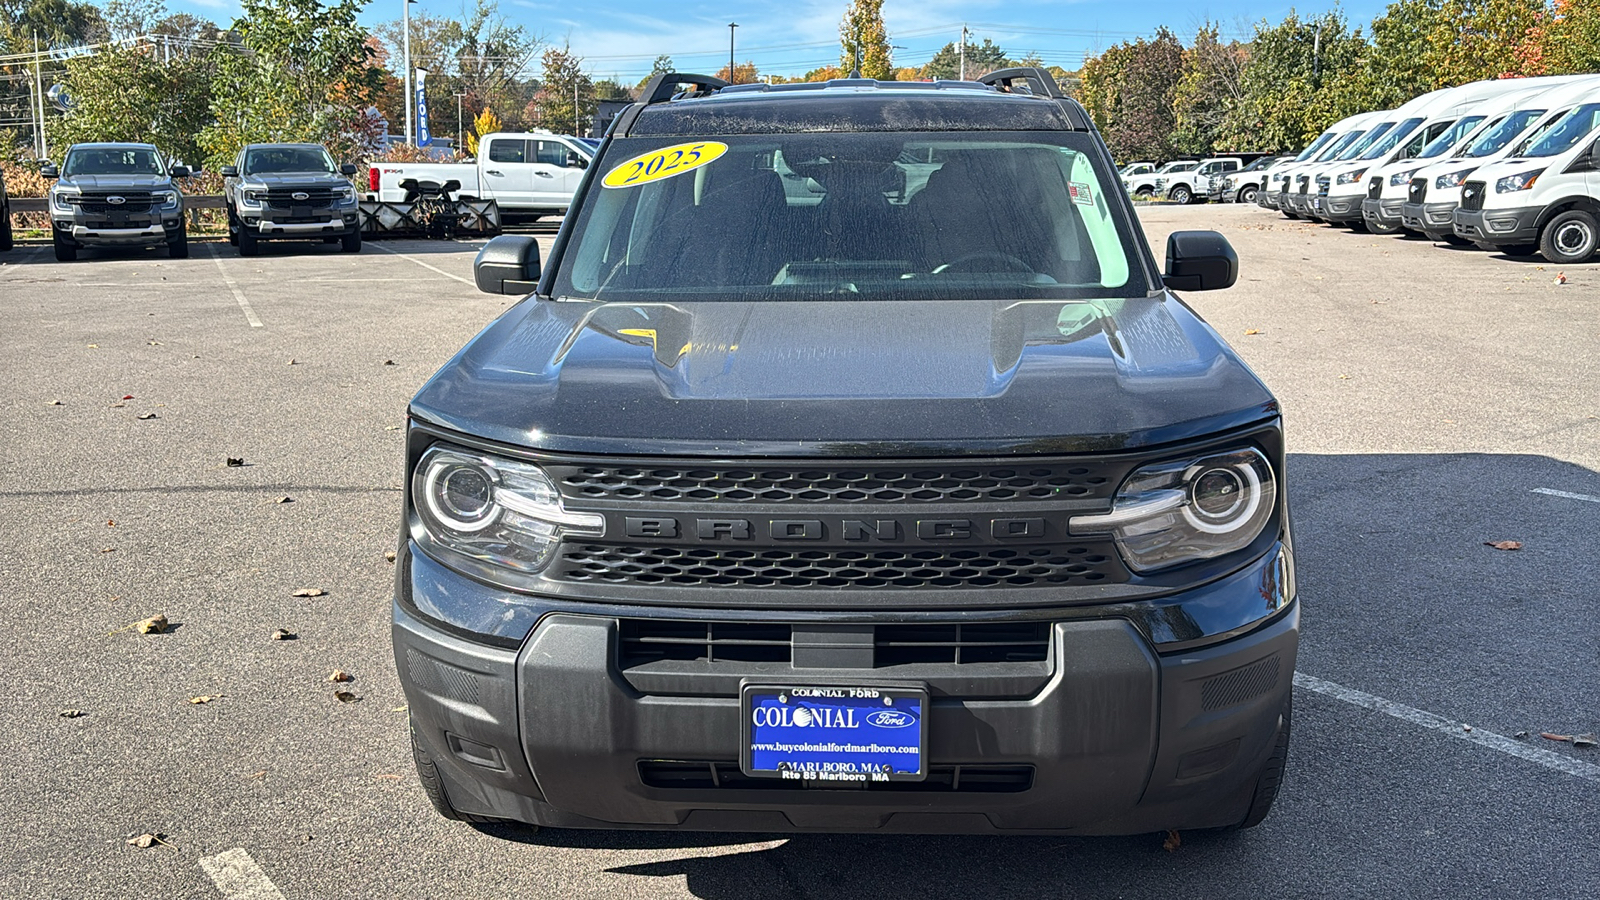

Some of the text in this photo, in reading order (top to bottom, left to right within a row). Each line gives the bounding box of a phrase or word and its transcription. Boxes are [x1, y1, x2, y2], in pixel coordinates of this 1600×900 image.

[419, 91, 428, 141] FORD
[623, 144, 706, 183] 2025
[624, 516, 1047, 540] BRONCO
[791, 688, 880, 699] COLONIAL FORD
[752, 706, 860, 728] COLONIAL
[875, 712, 906, 726] Ford
[751, 742, 918, 755] www.buycolonialfordmarlboro.com
[782, 771, 890, 782] Rte 85 Marlboro MA
